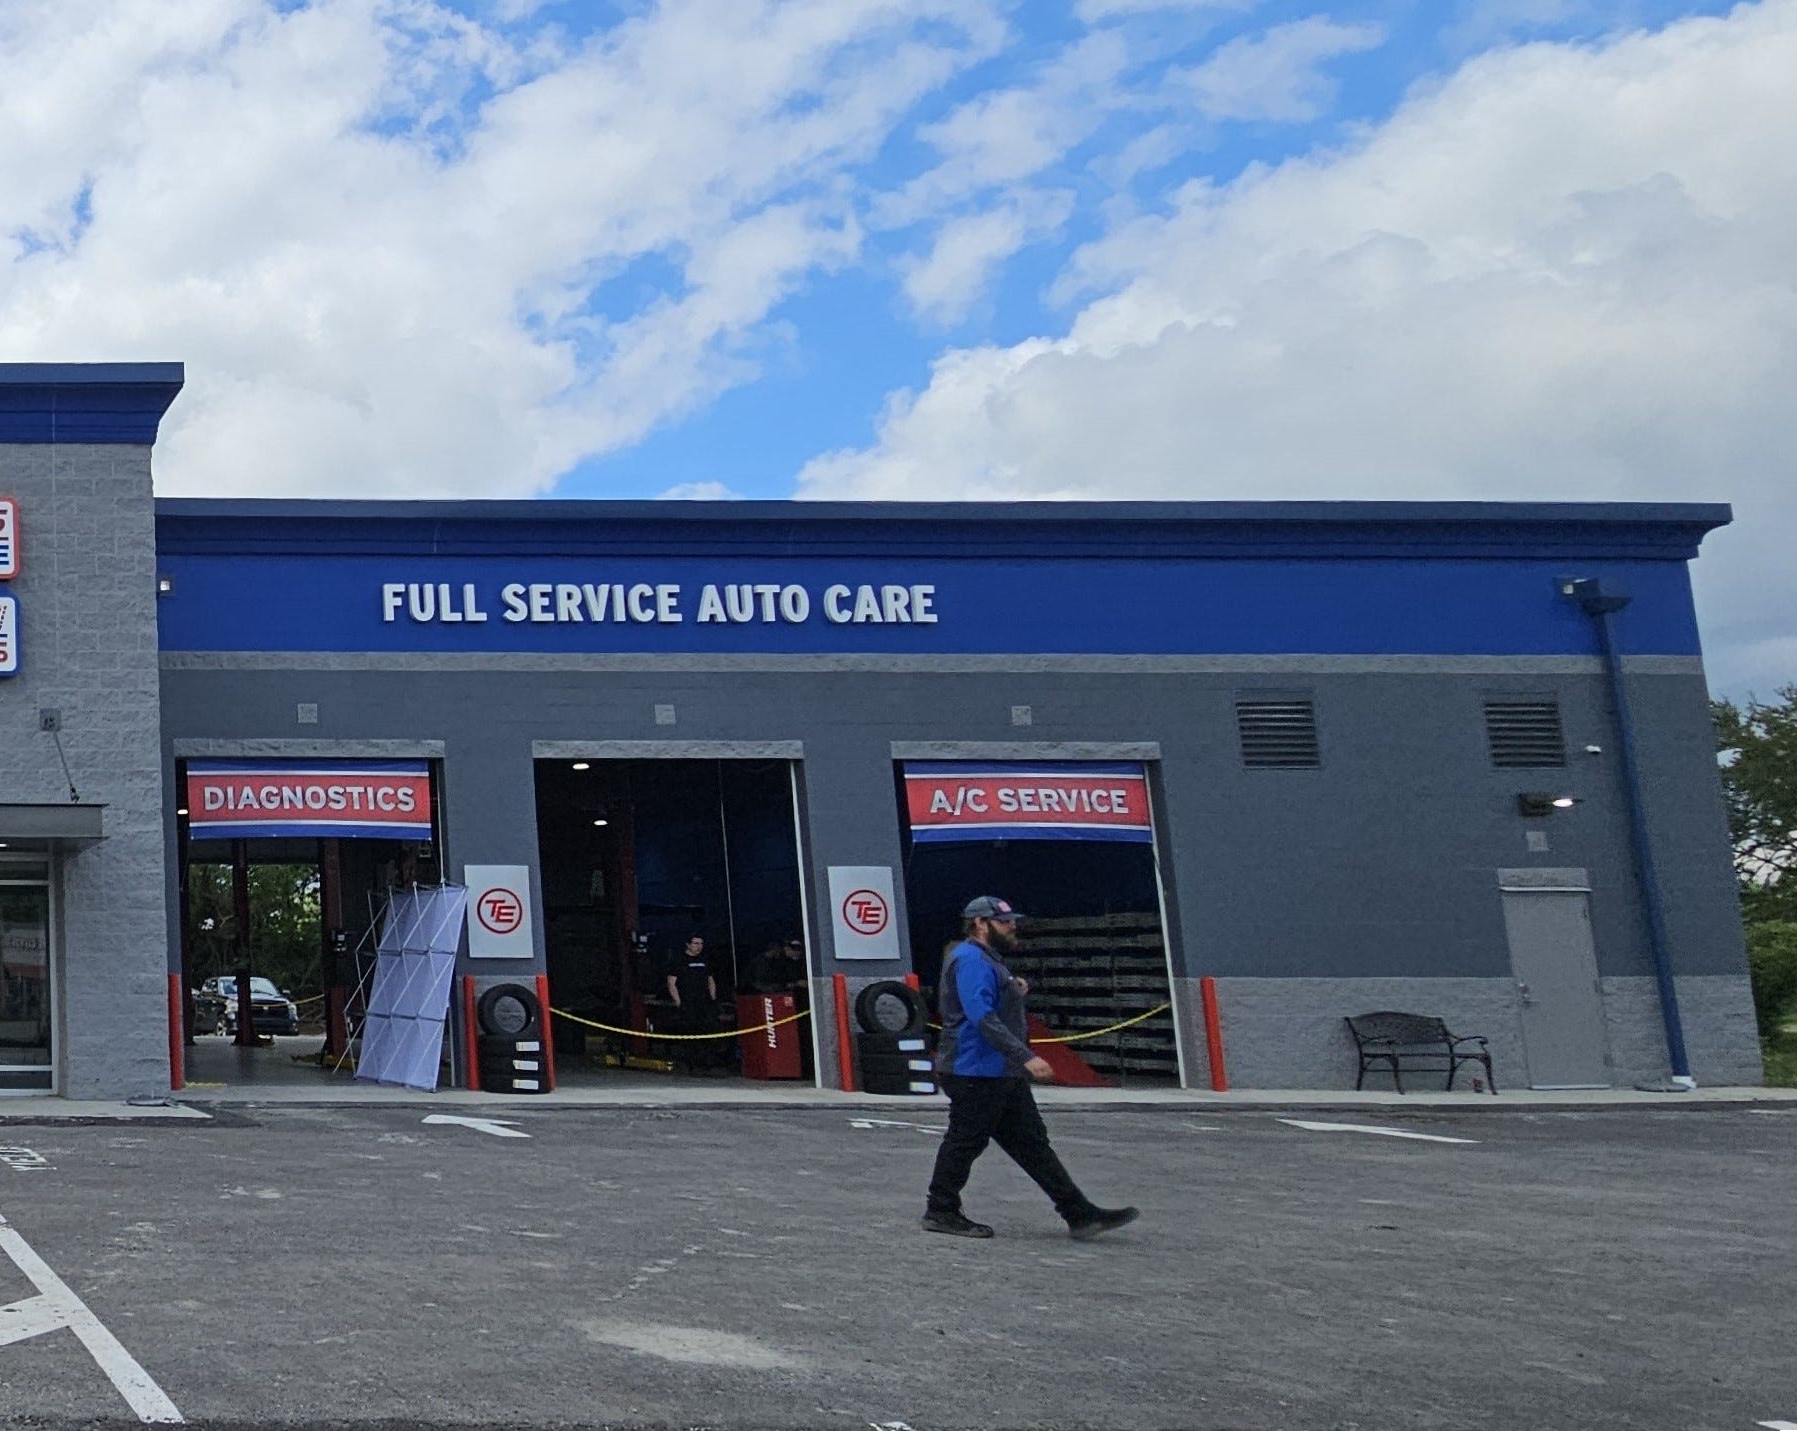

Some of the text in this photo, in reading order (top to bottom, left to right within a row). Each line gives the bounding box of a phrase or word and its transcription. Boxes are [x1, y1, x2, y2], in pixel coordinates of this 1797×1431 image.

[382, 583, 938, 624] FULL SERVICE AUTO CARE
[204, 786, 415, 812] DIAGNOSTICS
[930, 787, 1129, 816] A/C SERVICE
